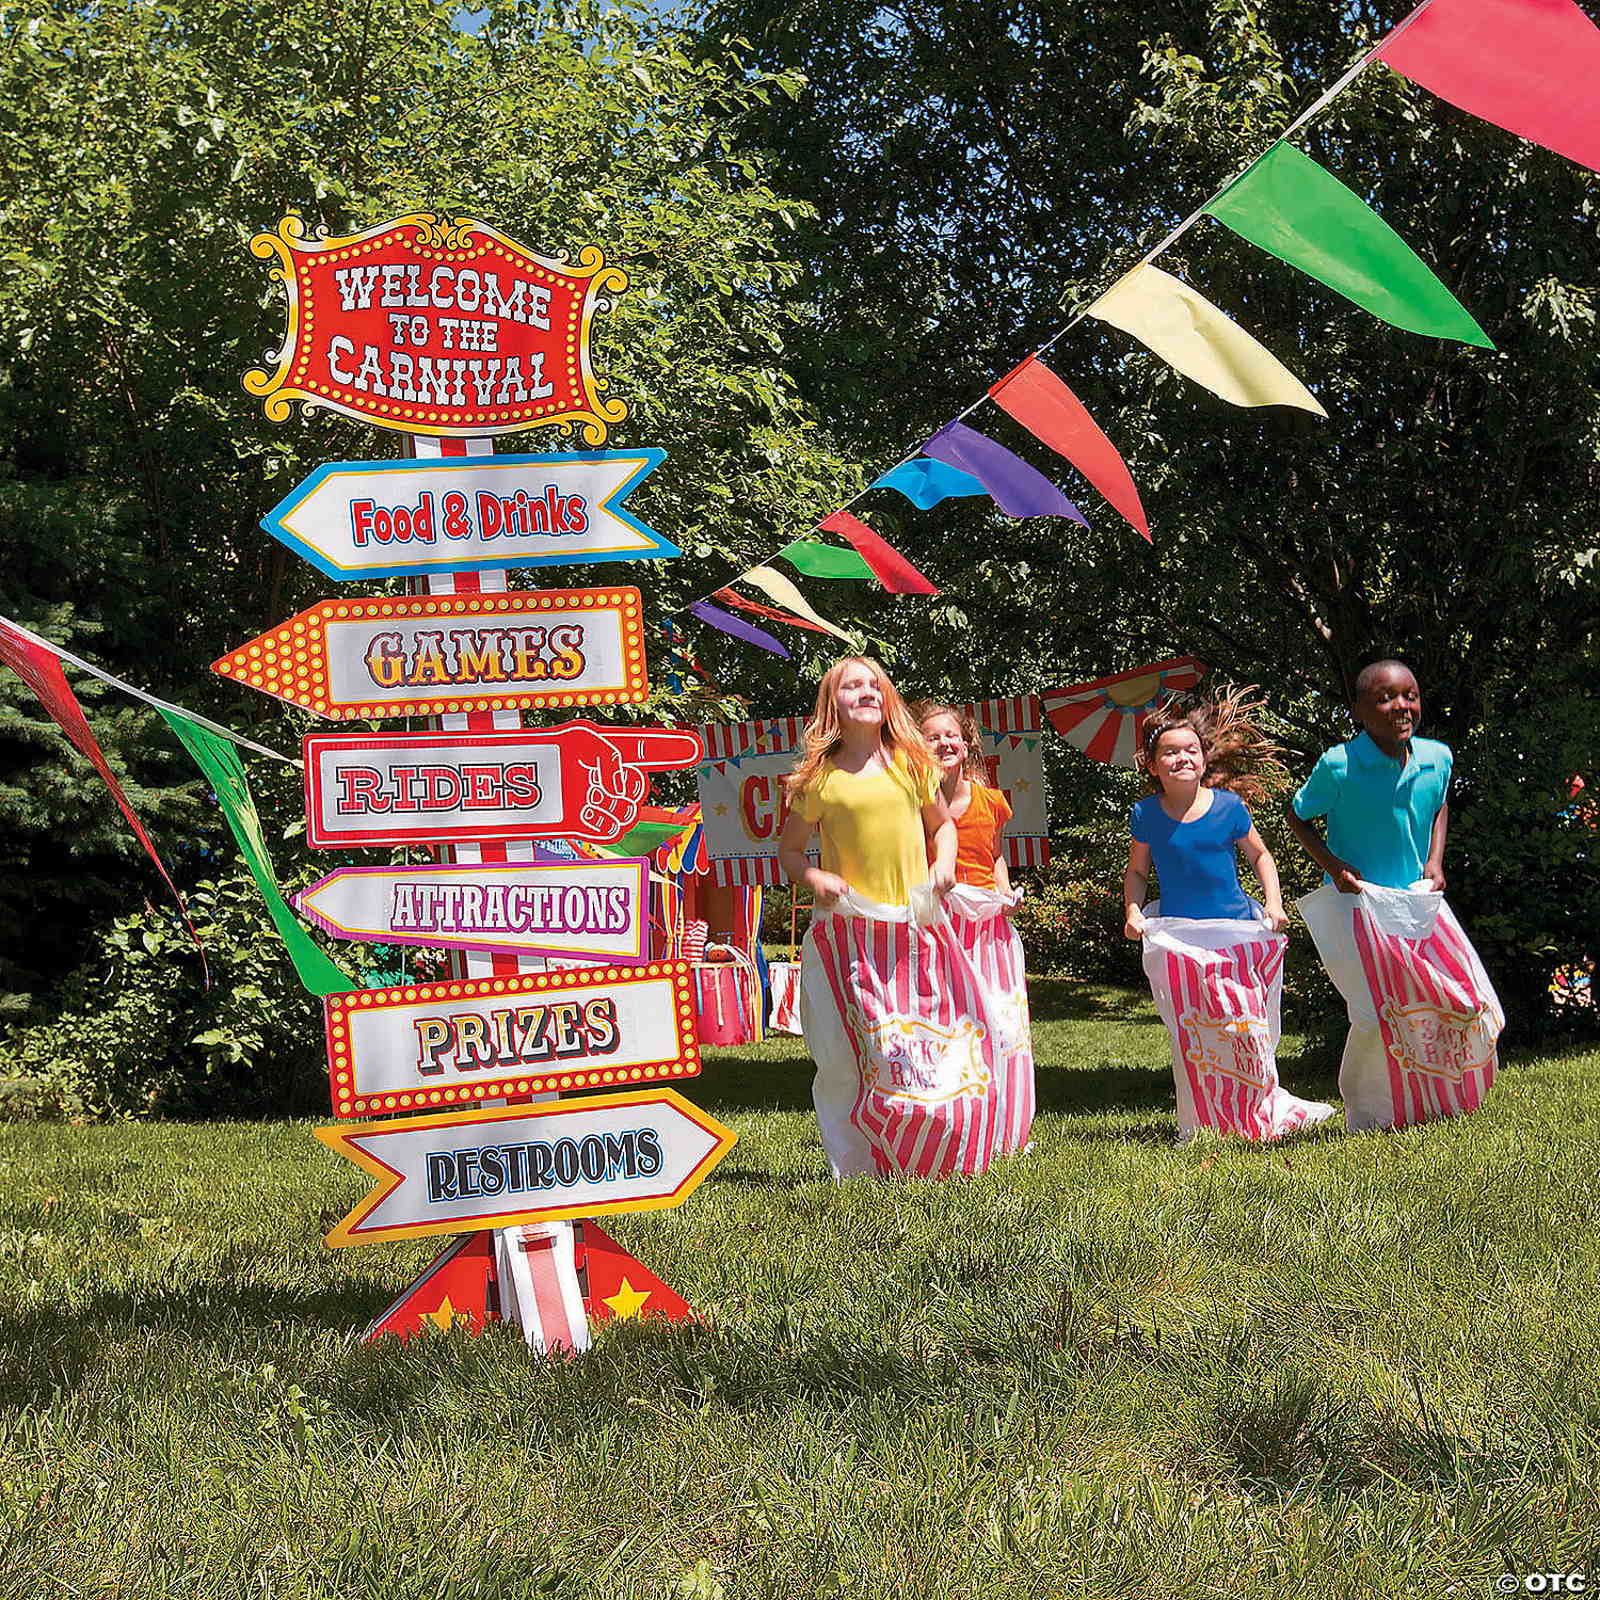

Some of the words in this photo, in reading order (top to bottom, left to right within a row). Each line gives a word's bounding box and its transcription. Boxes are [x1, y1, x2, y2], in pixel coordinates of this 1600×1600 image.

[335, 265, 551, 330] WELCOME
[388, 313, 430, 345] TO
[438, 318, 498, 352] THE
[327, 335, 554, 406] CARNIVAL
[350, 491, 436, 547] Food
[442, 490, 471, 540] &
[476, 485, 589, 541] Drinks
[364, 624, 586, 688] GAMES
[336, 761, 542, 815] RIDES
[391, 883, 630, 934] ATTRACTIONS
[413, 997, 618, 1076] PRIZES
[426, 1128, 663, 1203] RESTROOMS
